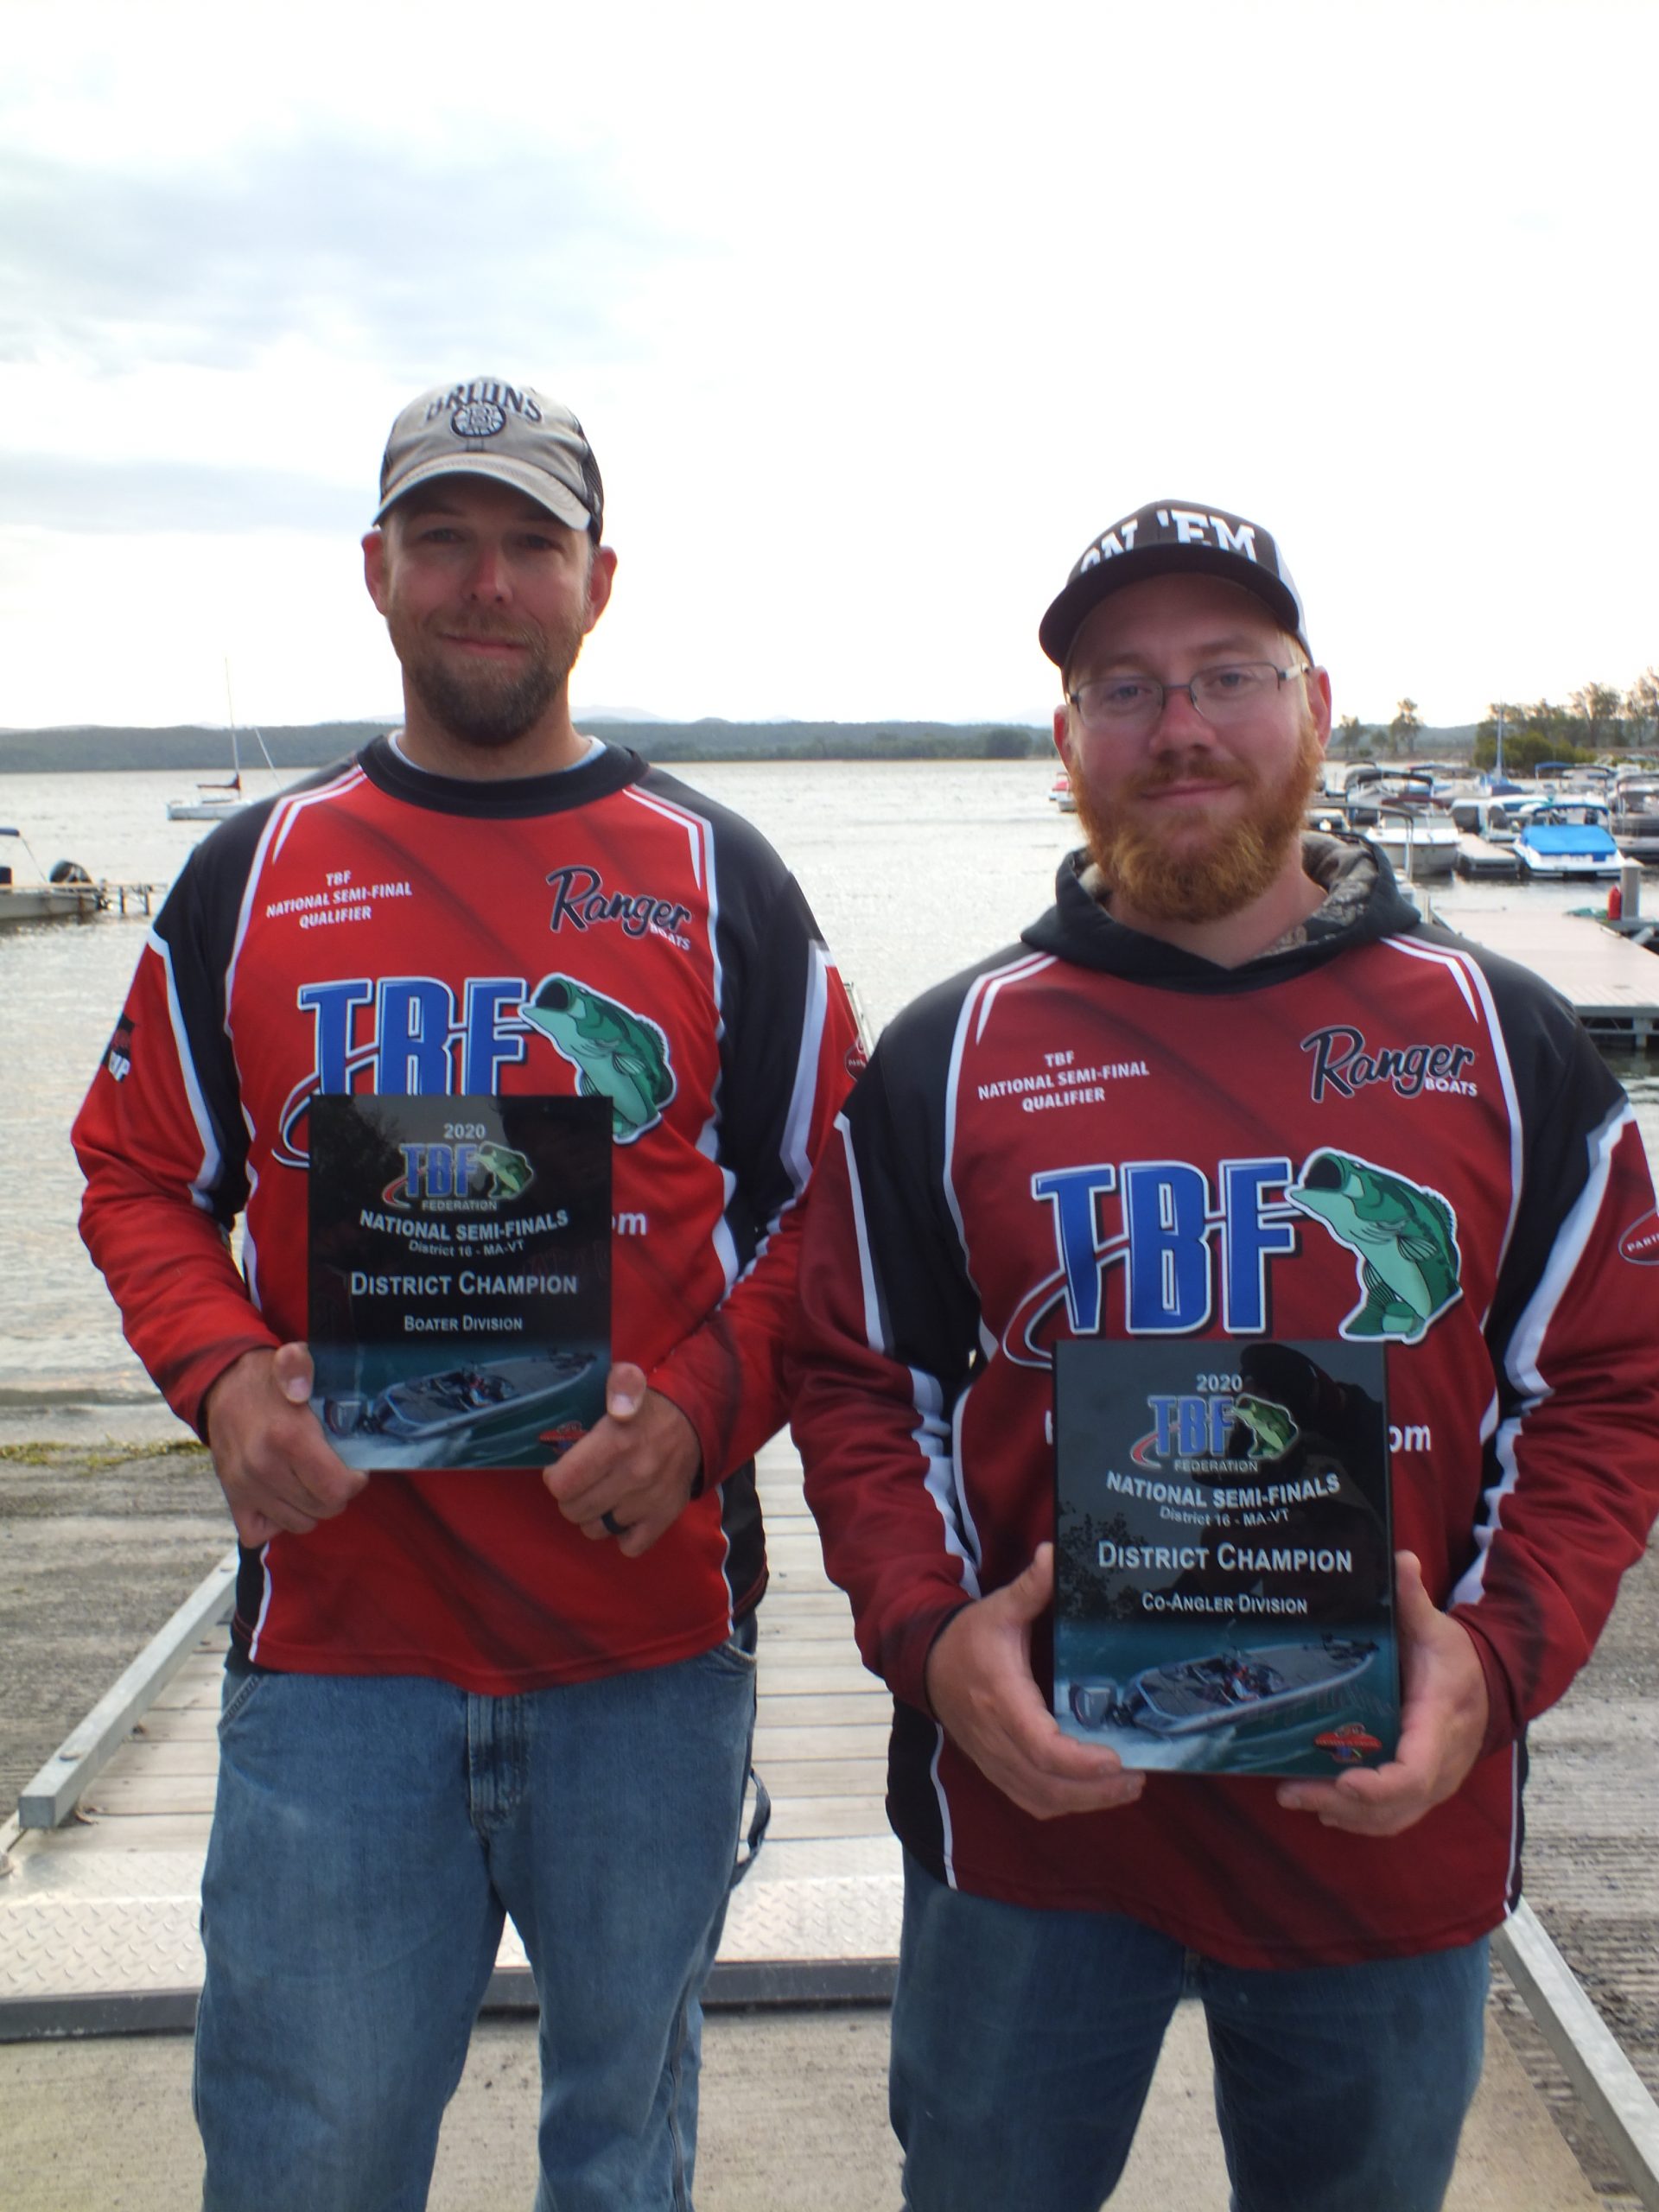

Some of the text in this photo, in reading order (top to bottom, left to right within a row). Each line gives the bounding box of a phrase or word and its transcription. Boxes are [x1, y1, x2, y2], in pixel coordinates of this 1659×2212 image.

[326, 869, 352, 887] TBF
[266, 880, 413, 918] NATIONAL SEMI-FINAL
[546, 864, 693, 939] Ranger
[299, 905, 372, 930] QUALIFIER
[1044, 1050, 1076, 1068] TBF
[1300, 1025, 1475, 1104] Ranger
[977, 1060, 1150, 1101] NATIONAL SEMI-FINAL
[1425, 1077, 1478, 1097] BOATS
[1021, 1086, 1106, 1113] QUALIFIER
[443, 1123, 486, 1141] 2020
[398, 1141, 480, 1198] TBF
[422, 1199, 498, 1211] FEDERATION
[359, 1209, 569, 1242] NATIONAL SEMI-FINALS
[408, 1239, 454, 1257] District
[483, 1238, 524, 1256] MA-VT
[1031, 1155, 1296, 1335] TBF
[350, 1269, 578, 1296] DISTRICT CHAMPION
[1196, 1373, 1243, 1393] 2020
[1146, 1395, 1235, 1458] TBF
[1173, 1459, 1259, 1473] FEDERATION
[1106, 1470, 1341, 1510] NATIONAL SEMI-FINALS
[1159, 1505, 1211, 1526] District
[1216, 1510, 1231, 1528] 16
[1243, 1508, 1290, 1528] MA-VT
[1098, 1539, 1353, 1573] DISTRICT CHAMPION
